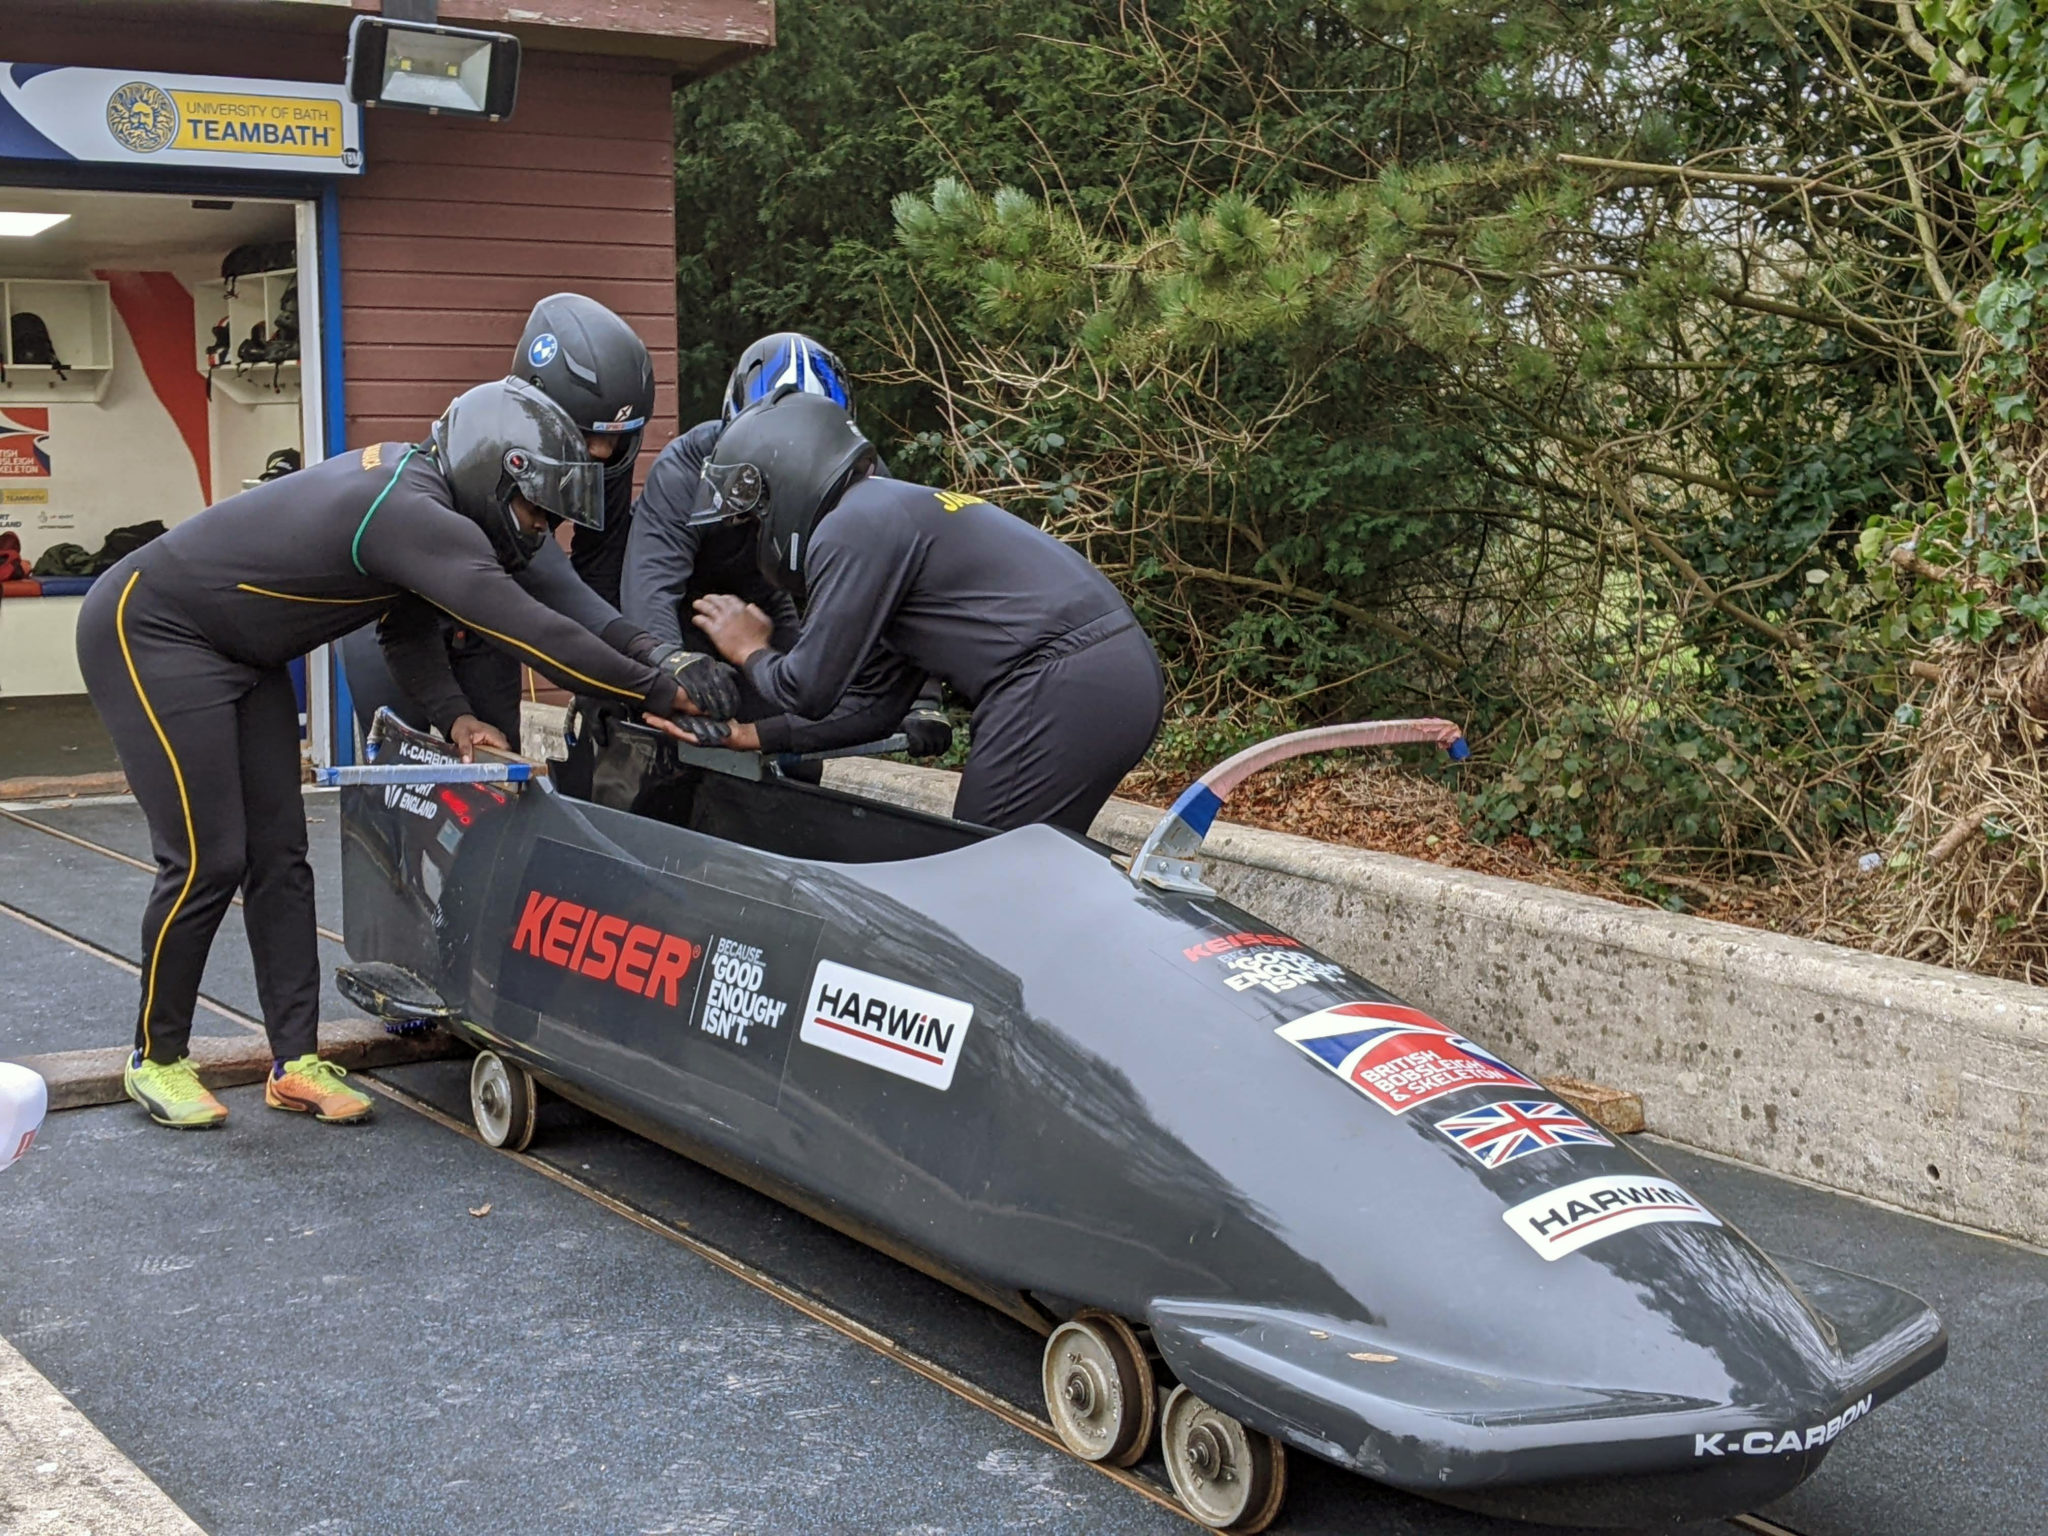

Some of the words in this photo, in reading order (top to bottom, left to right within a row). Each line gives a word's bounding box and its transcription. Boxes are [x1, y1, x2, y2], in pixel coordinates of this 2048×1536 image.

[186, 102, 267, 119] UNIVERSITY
[271, 106, 289, 119] OF
[293, 107, 329, 122] BATH
[399, 792, 438, 820] ENGLAND
[1182, 932, 1303, 963] KEISER
[1360, 1049, 1441, 1084] BRITISH
[1374, 1058, 1487, 1094] BOBSLEIGH
[1389, 1089, 1412, 1103] &
[1407, 1069, 1509, 1096] SKELETON
[1694, 1393, 1873, 1457] K-CARBON
